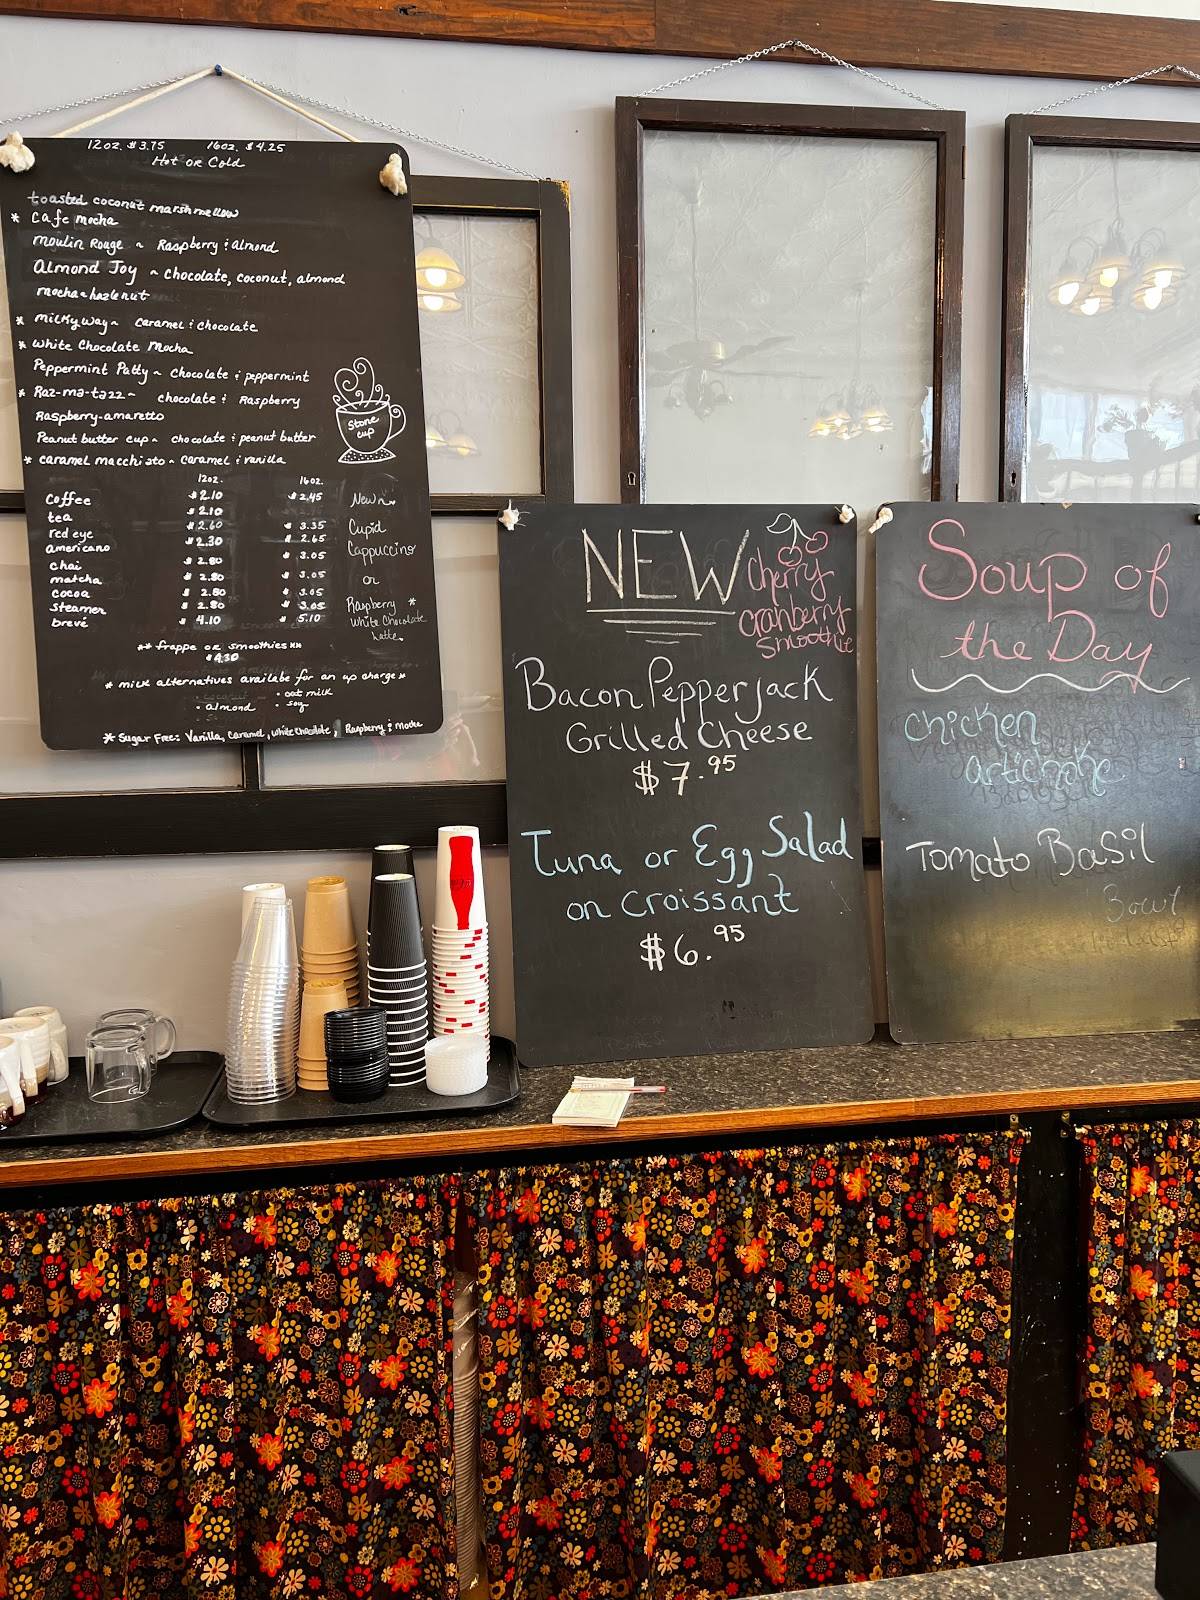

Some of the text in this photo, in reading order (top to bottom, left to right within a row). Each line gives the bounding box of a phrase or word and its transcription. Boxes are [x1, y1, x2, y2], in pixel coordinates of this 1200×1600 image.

[151, 153, 179, 167] Hot
[207, 156, 245, 168] Cold
[27, 191, 88, 206] toasted
[92, 198, 145, 211] coconut
[90, 238, 124, 256] Rouge
[157, 236, 219, 255] Raspberry
[108, 260, 138, 286] Joy
[296, 273, 346, 285] almond
[33, 358, 109, 377] Peppermint
[116, 362, 149, 385] Patty
[243, 370, 310, 387] peppermint
[238, 394, 301, 410] Raspberry
[36, 431, 78, 444] Peanut
[80, 433, 119, 445] butter
[125, 436, 149, 447] cup
[238, 432, 277, 447] peanut
[279, 430, 317, 444] butter
[356, 427, 376, 440] cup
[45, 491, 92, 508] Coffee
[47, 511, 73, 524] tea
[48, 527, 69, 539] red
[72, 530, 94, 544] eye
[347, 517, 387, 541] Cupid
[49, 559, 82, 572] chai
[581, 527, 751, 606] NEW
[917, 518, 1172, 624] Soup of
[49, 574, 103, 586] matcha
[345, 595, 397, 618] Raspberry
[155, 640, 197, 655] frappe
[939, 608, 1154, 695] the Day
[155, 675, 234, 689] alternatives
[294, 668, 315, 687] for
[319, 674, 337, 682] an
[342, 675, 358, 685] up
[361, 671, 397, 686] charge
[513, 655, 644, 713] Bacon
[283, 690, 304, 699] oat
[205, 701, 310, 714] almond soy
[564, 716, 814, 755] Grilled Cheese
[520, 810, 856, 889] Tuna or Egg Salad
[904, 834, 1032, 884] Tomato
[565, 899, 613, 922] on
